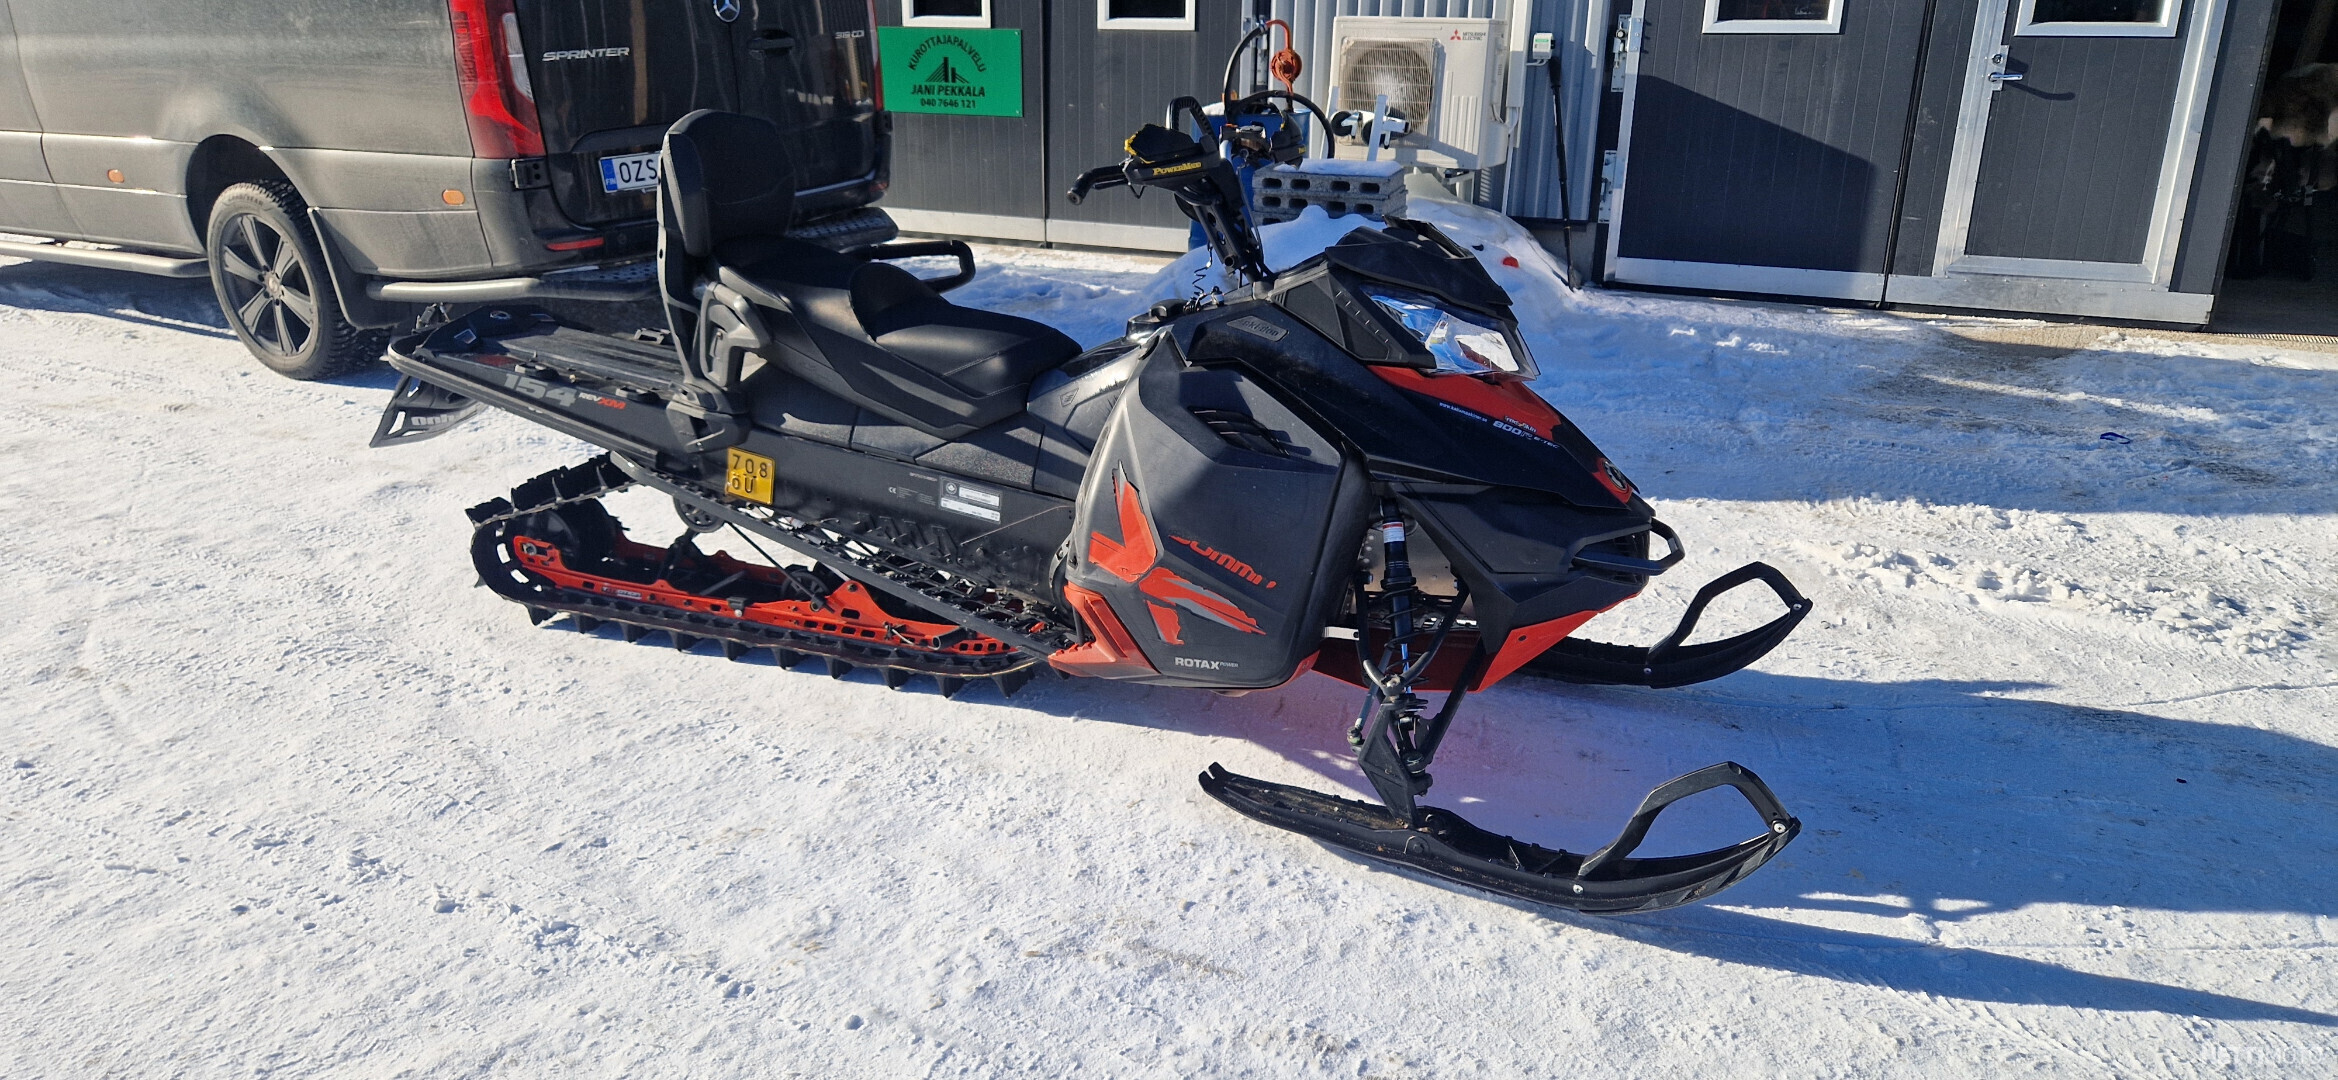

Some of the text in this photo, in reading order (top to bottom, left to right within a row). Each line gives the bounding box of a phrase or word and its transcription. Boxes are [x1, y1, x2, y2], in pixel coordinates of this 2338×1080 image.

[541, 46, 631, 62] SPRINTER
[908, 34, 987, 73] KUROTTAJAPALVELU
[911, 84, 985, 97] JANI PEKKALA
[921, 98, 976, 109] 040 7646 121
[618, 158, 658, 184] OZS
[502, 373, 578, 408] 154
[732, 453, 768, 478] 708
[1174, 656, 1220, 670] ROTAX
